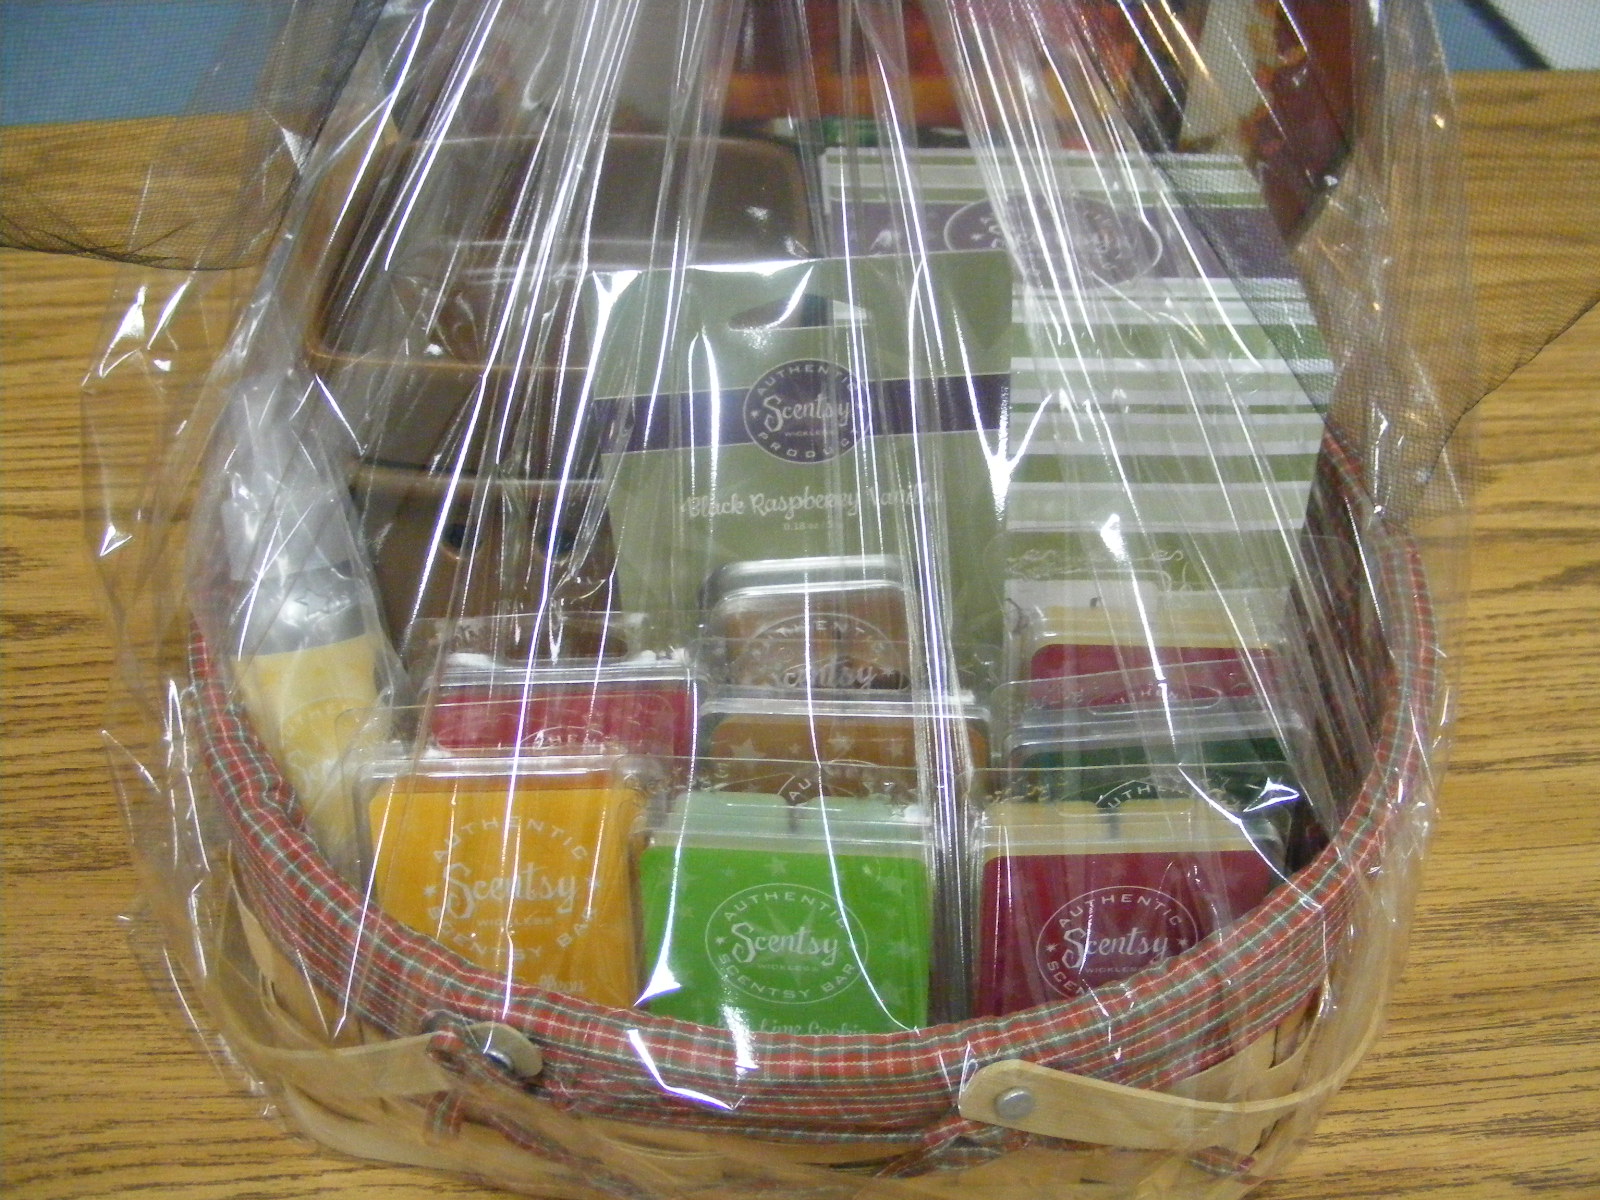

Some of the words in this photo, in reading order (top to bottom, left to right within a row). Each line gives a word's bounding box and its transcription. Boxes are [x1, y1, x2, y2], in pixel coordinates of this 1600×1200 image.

[763, 393, 850, 433] Scentsy
[442, 861, 578, 920] Scentsy
[724, 891, 848, 930] AUTHENTIC
[1058, 892, 1182, 928] AUTHENTIC
[731, 921, 839, 967] Scentsy
[1061, 926, 1169, 970] Scentsy
[718, 953, 810, 999] SCENTSY
